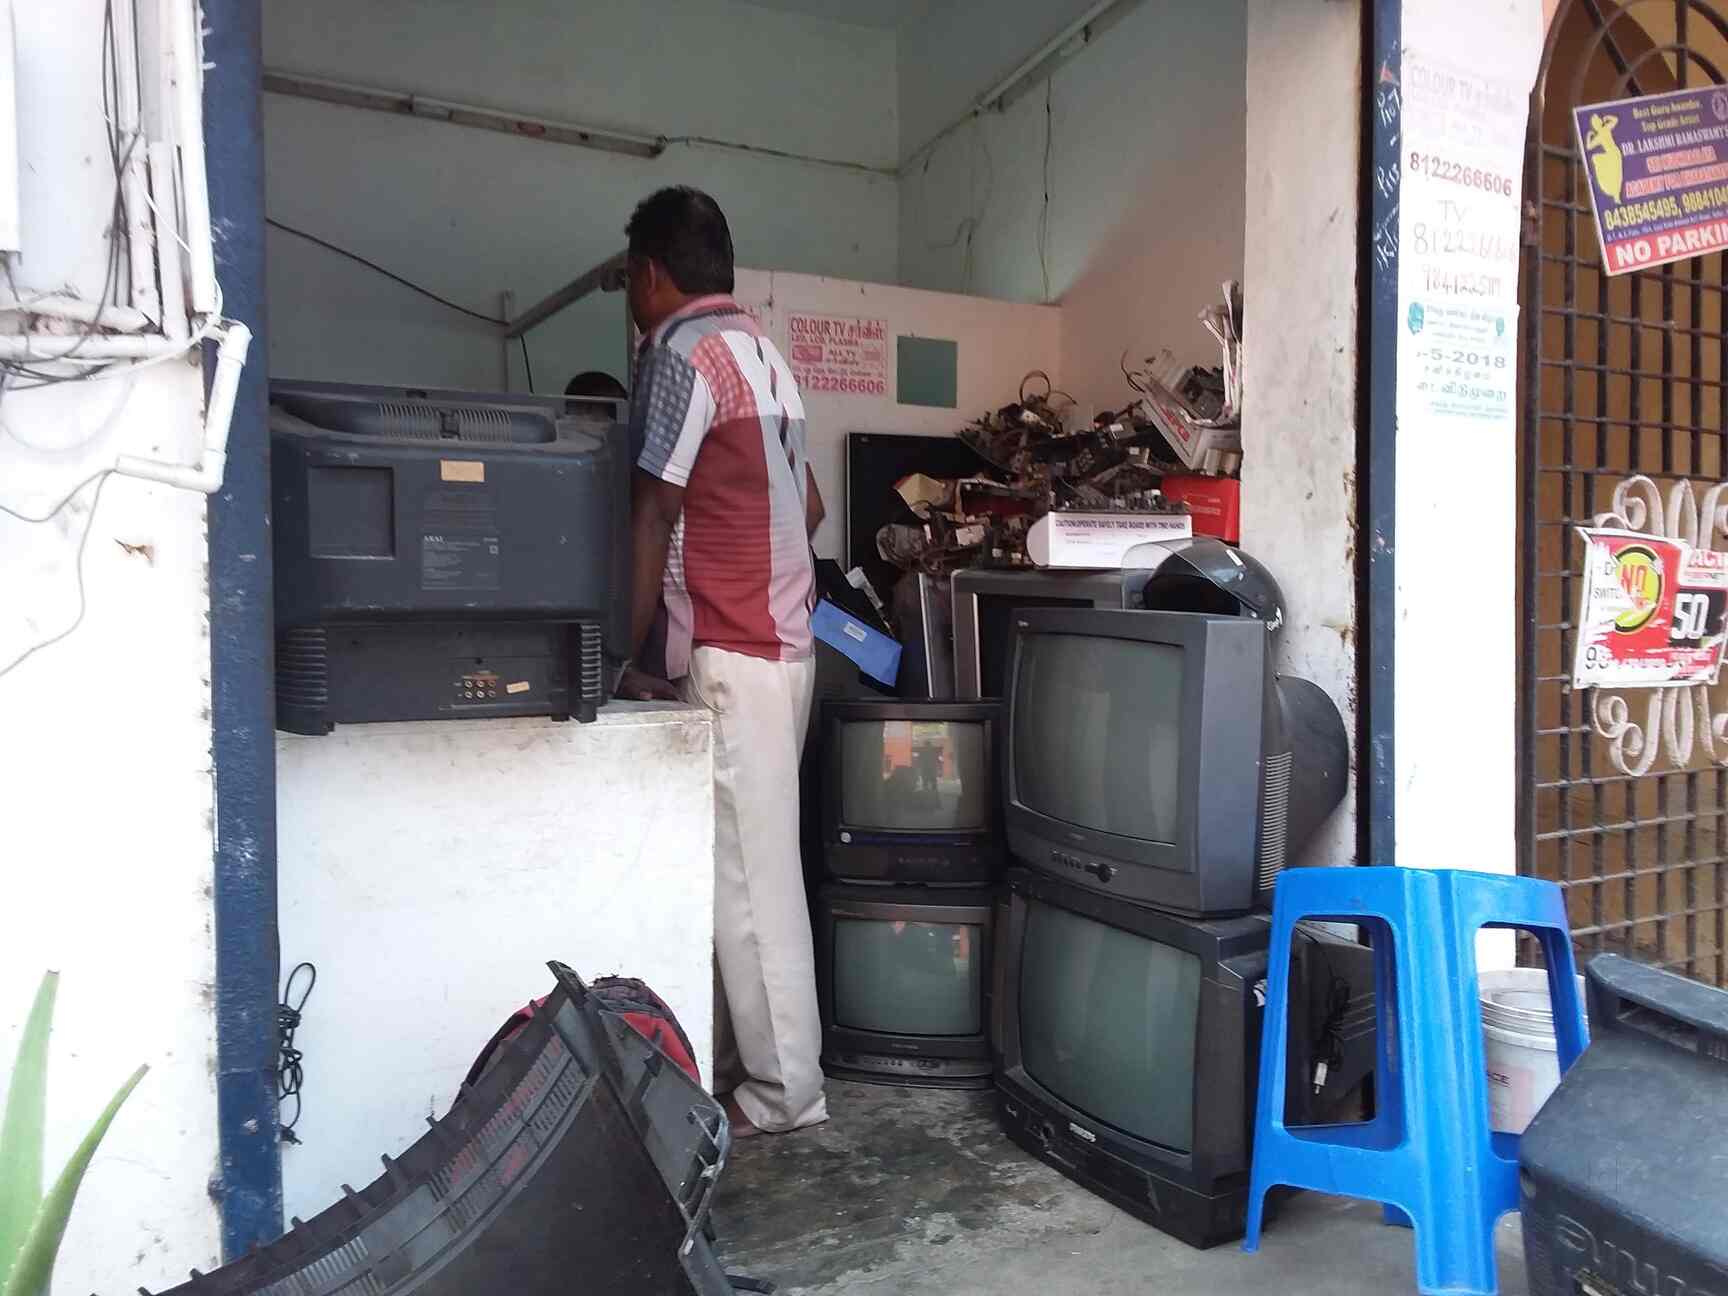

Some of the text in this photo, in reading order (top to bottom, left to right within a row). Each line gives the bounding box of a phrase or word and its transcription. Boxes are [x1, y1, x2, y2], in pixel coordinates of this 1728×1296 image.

[1638, 135, 1676, 153] LAKSHMI
[1409, 151, 1512, 197] 8122266606
[1615, 240, 1652, 267] NO
[791, 316, 846, 337] COLOUR TV
[1671, 592, 1710, 640] 50
